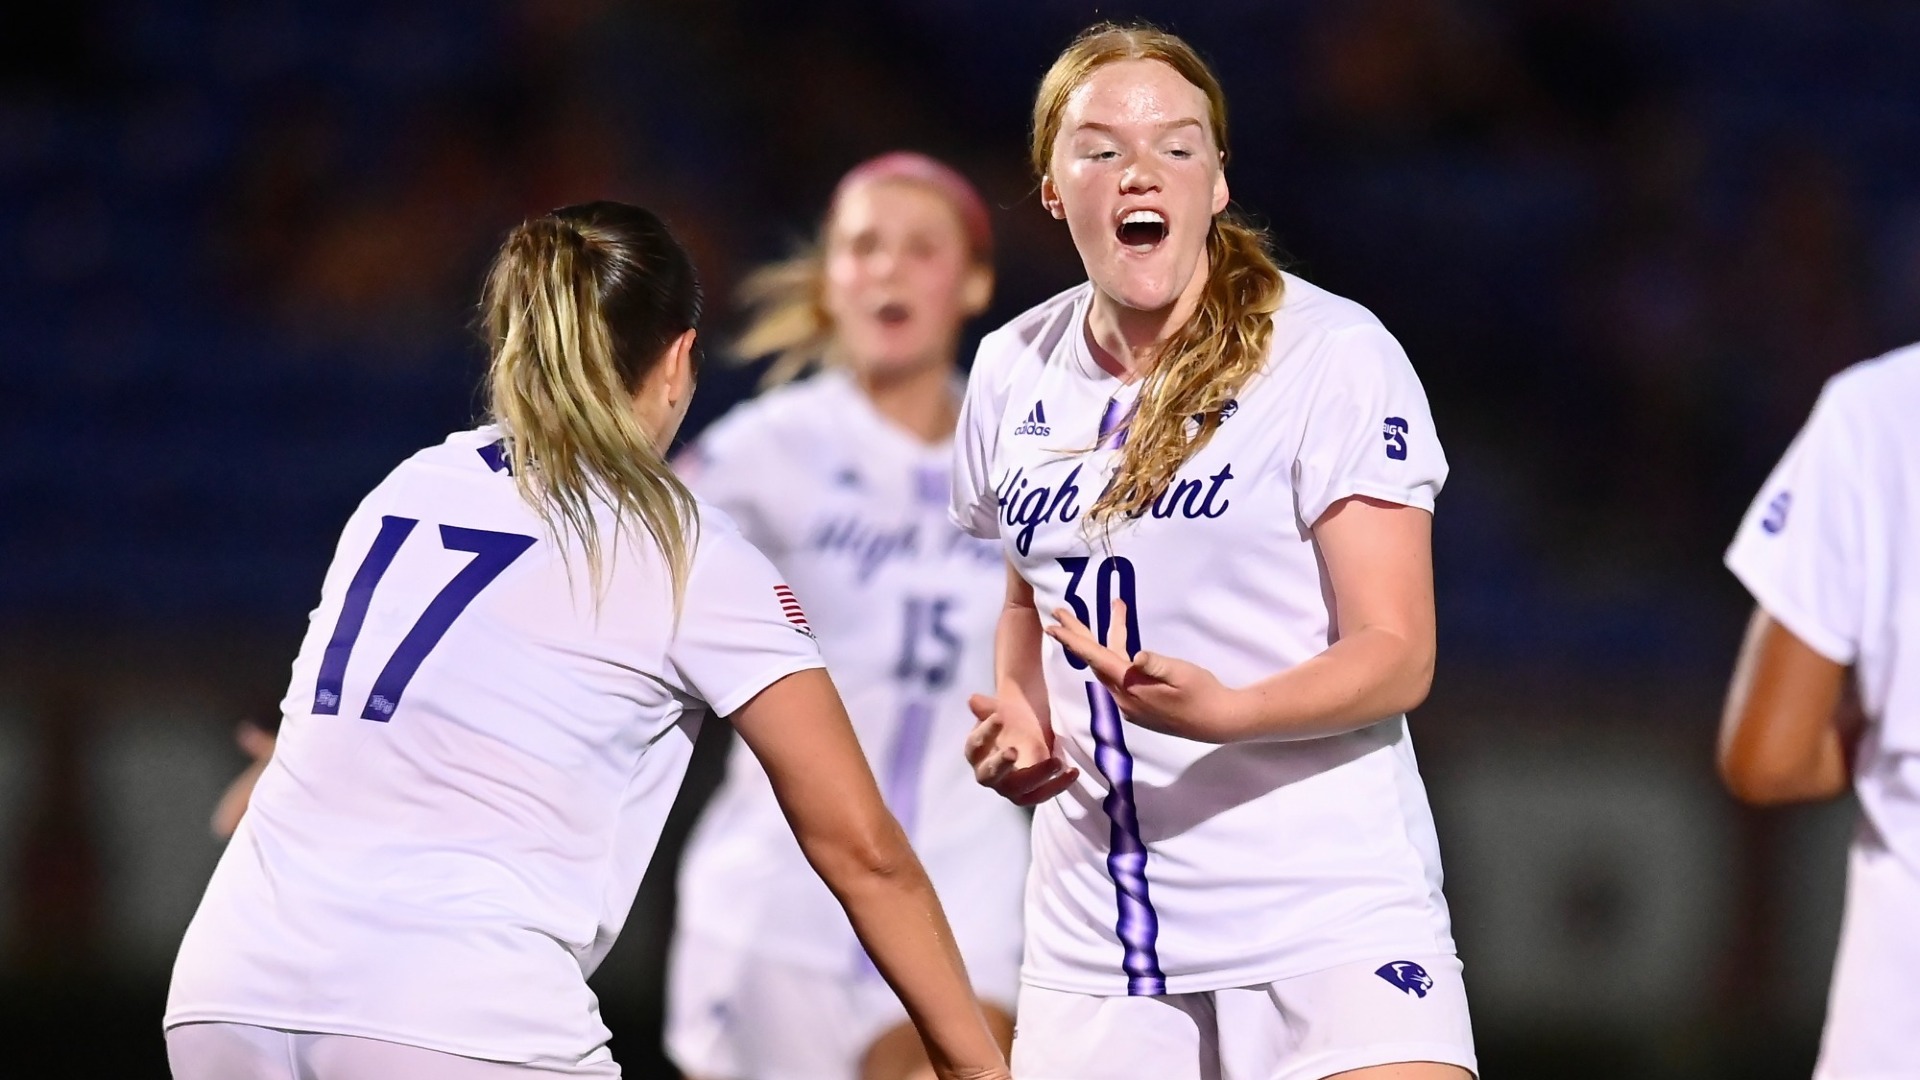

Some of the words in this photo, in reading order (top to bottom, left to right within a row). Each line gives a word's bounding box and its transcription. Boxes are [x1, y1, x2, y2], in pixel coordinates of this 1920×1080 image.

[1014, 419, 1051, 437] adidas
[311, 515, 539, 723] 17
[895, 595, 962, 692] 15
[1055, 555, 1142, 670] 30
